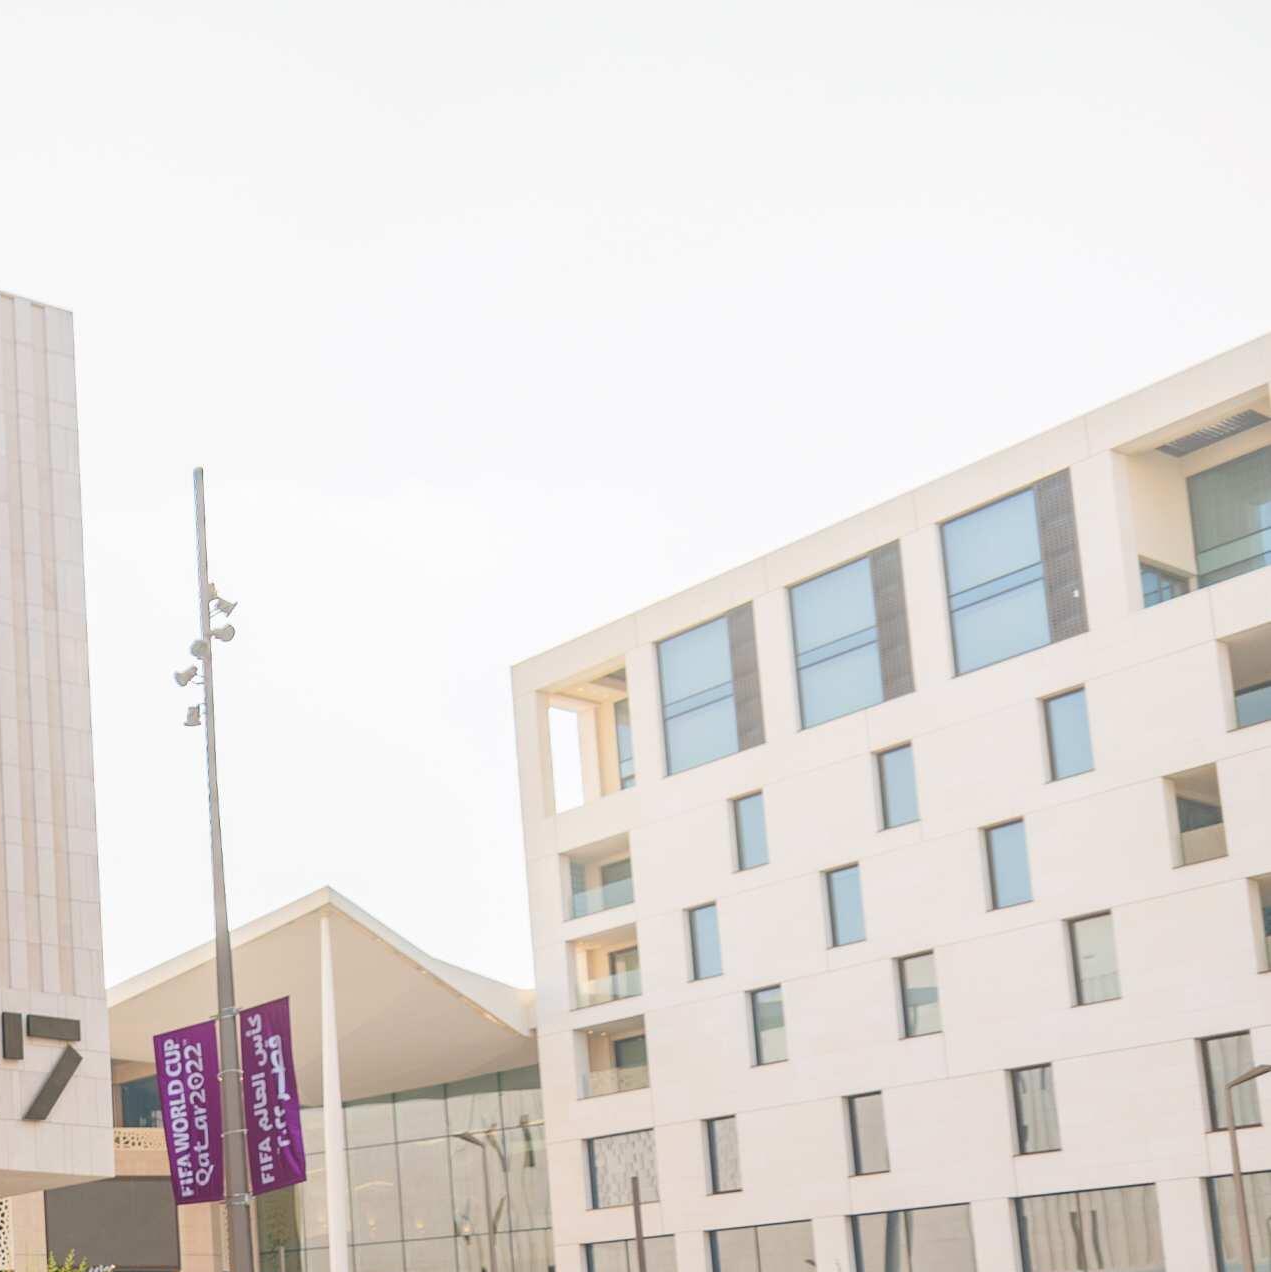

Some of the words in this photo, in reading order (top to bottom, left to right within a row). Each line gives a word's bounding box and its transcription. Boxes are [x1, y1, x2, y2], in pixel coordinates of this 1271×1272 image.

[163, 1038, 183, 1077] CUP
[265, 1034, 291, 1101] قطر
[167, 1080, 190, 1153] WORLD
[251, 1072, 274, 1132] العالم
[176, 1154, 195, 1198] FIFA
[258, 1137, 275, 1185] FIFA
